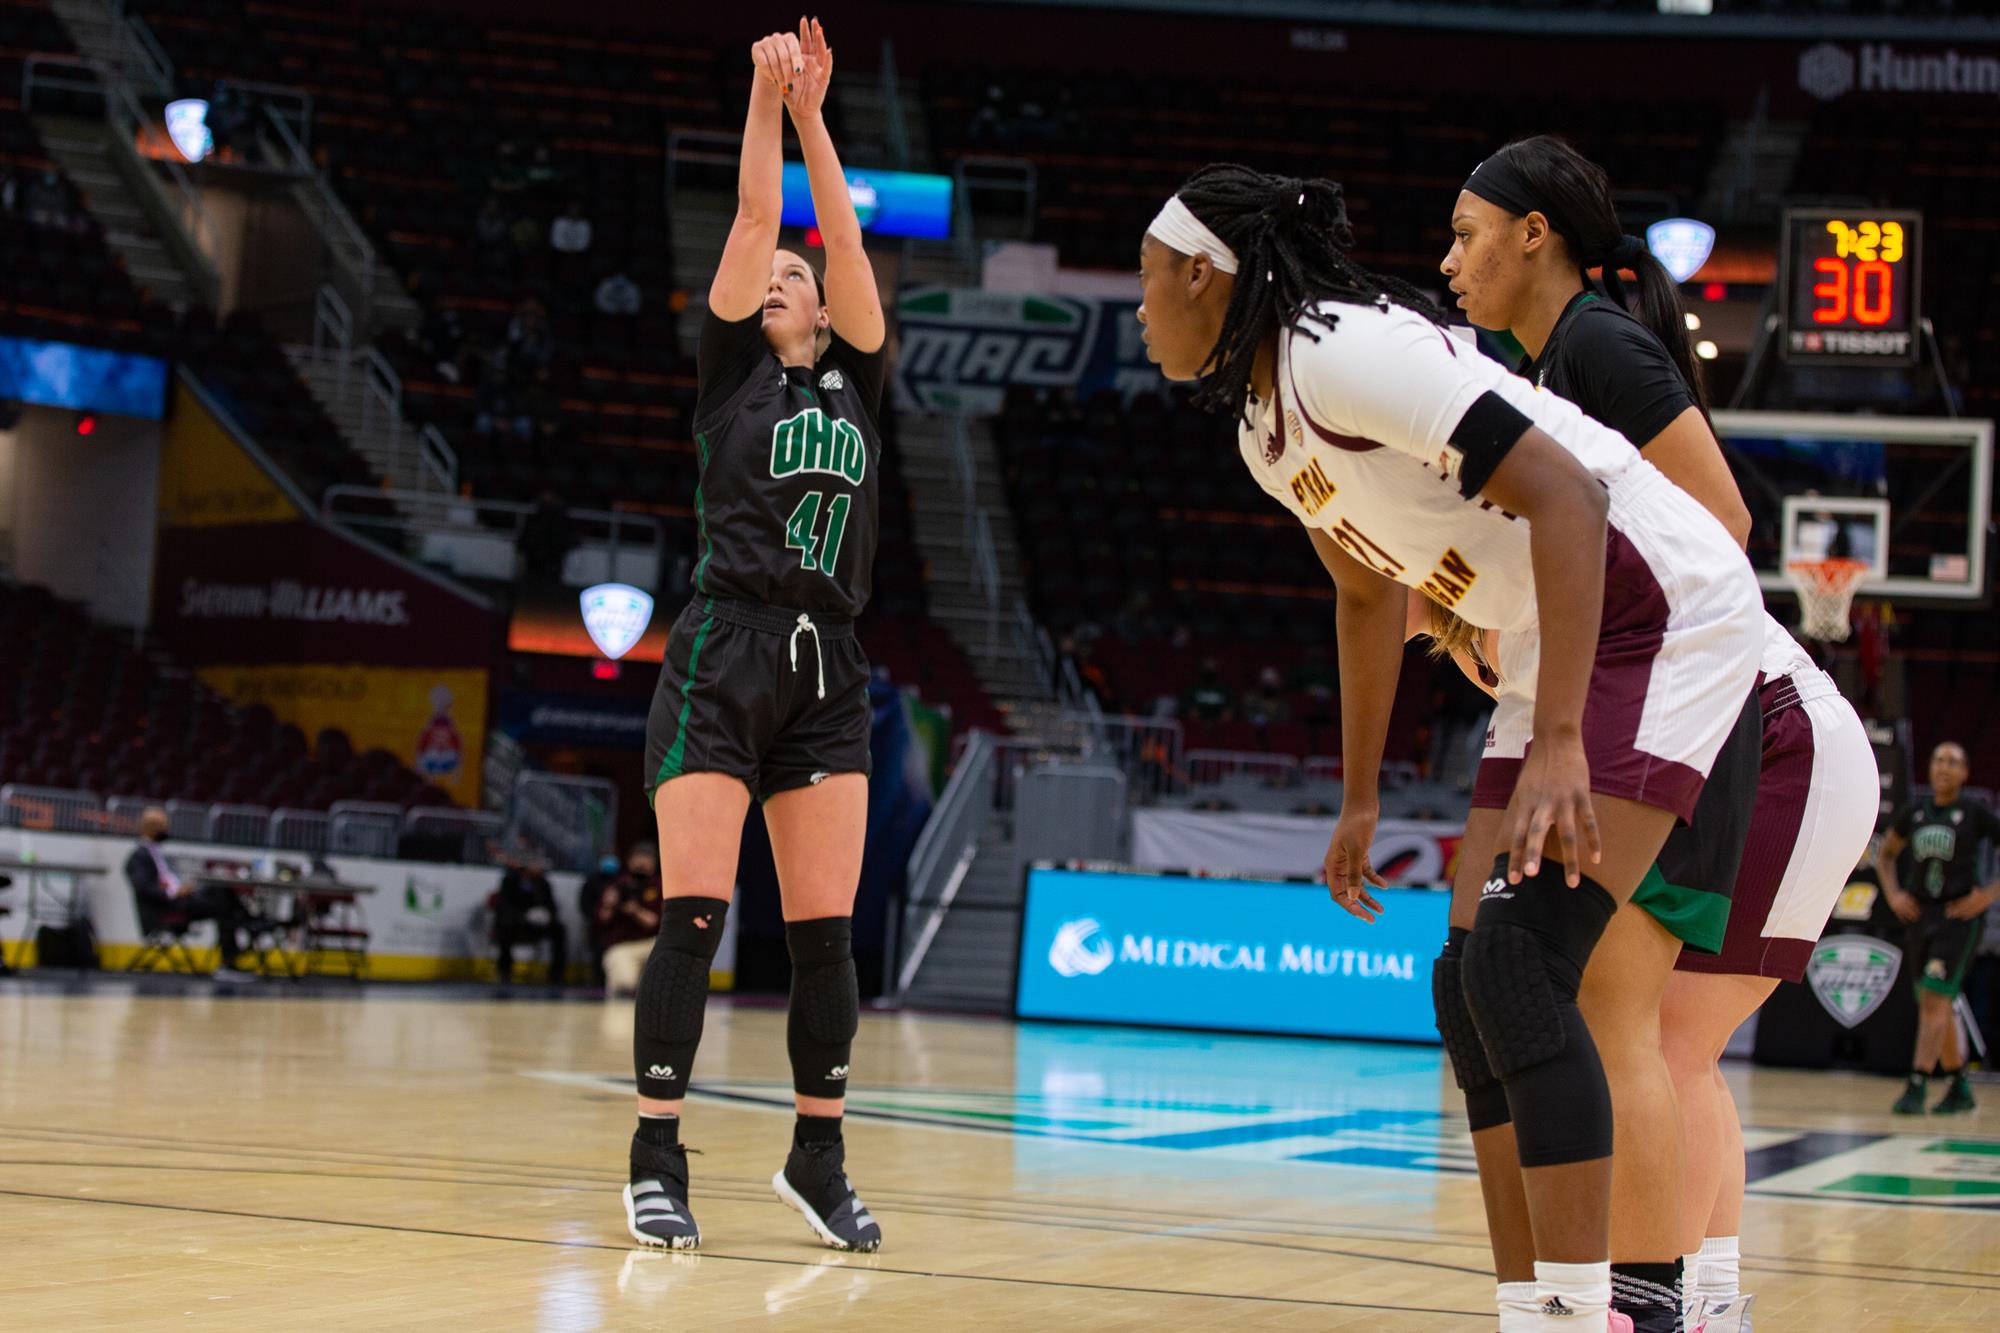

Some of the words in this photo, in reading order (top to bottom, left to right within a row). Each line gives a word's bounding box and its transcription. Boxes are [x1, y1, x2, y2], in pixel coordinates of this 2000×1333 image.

[1826, 220, 1904, 262] 7:23
[1812, 257, 1893, 325] 30
[899, 326, 1077, 383] MAC
[1825, 331, 1911, 354] TISSOT
[770, 408, 867, 486] OHIO
[785, 490, 852, 577] 41
[1120, 933, 1267, 972] MEDICAL
[1278, 943, 1417, 981] MUTUAL
